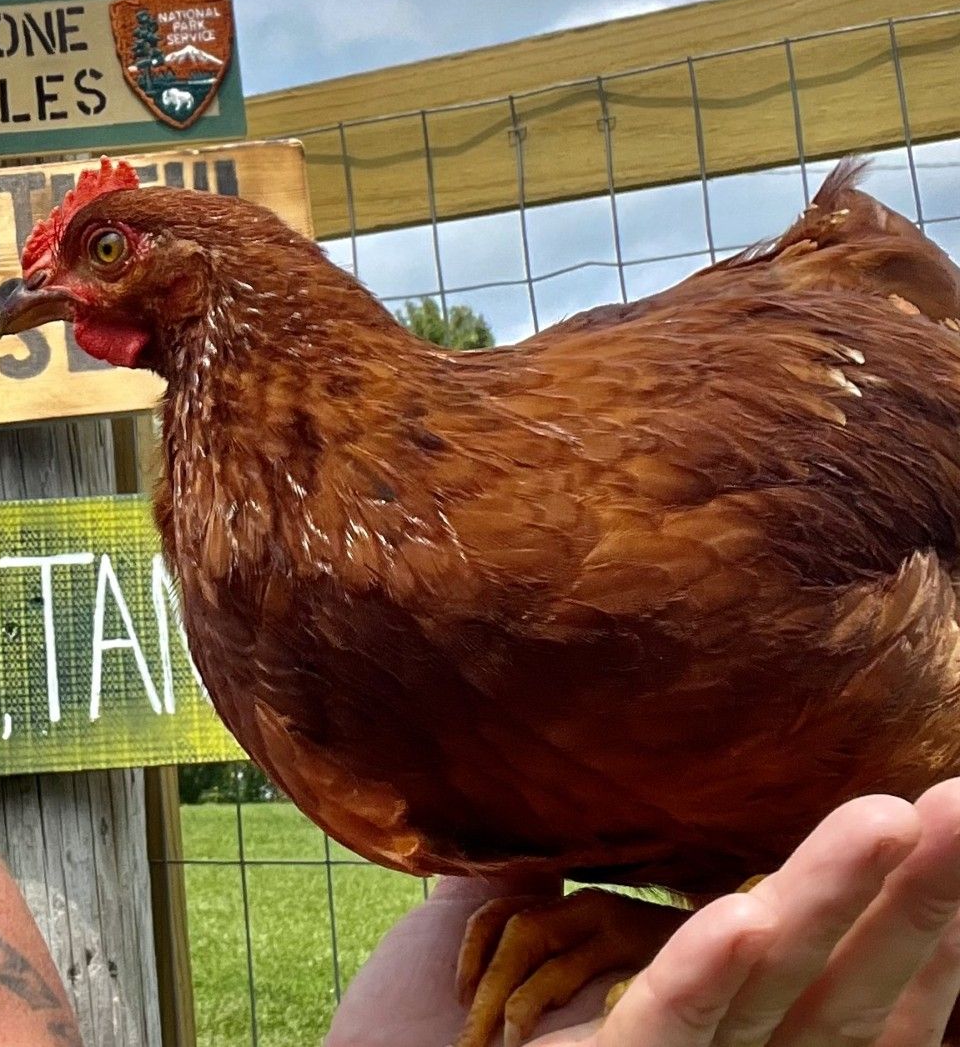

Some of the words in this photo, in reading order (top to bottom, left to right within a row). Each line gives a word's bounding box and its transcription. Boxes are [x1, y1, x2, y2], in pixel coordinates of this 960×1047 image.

[158, 7, 221, 23] NATIONAL
[172, 19, 206, 32] PARK
[166, 30, 216, 45] SERVICE
